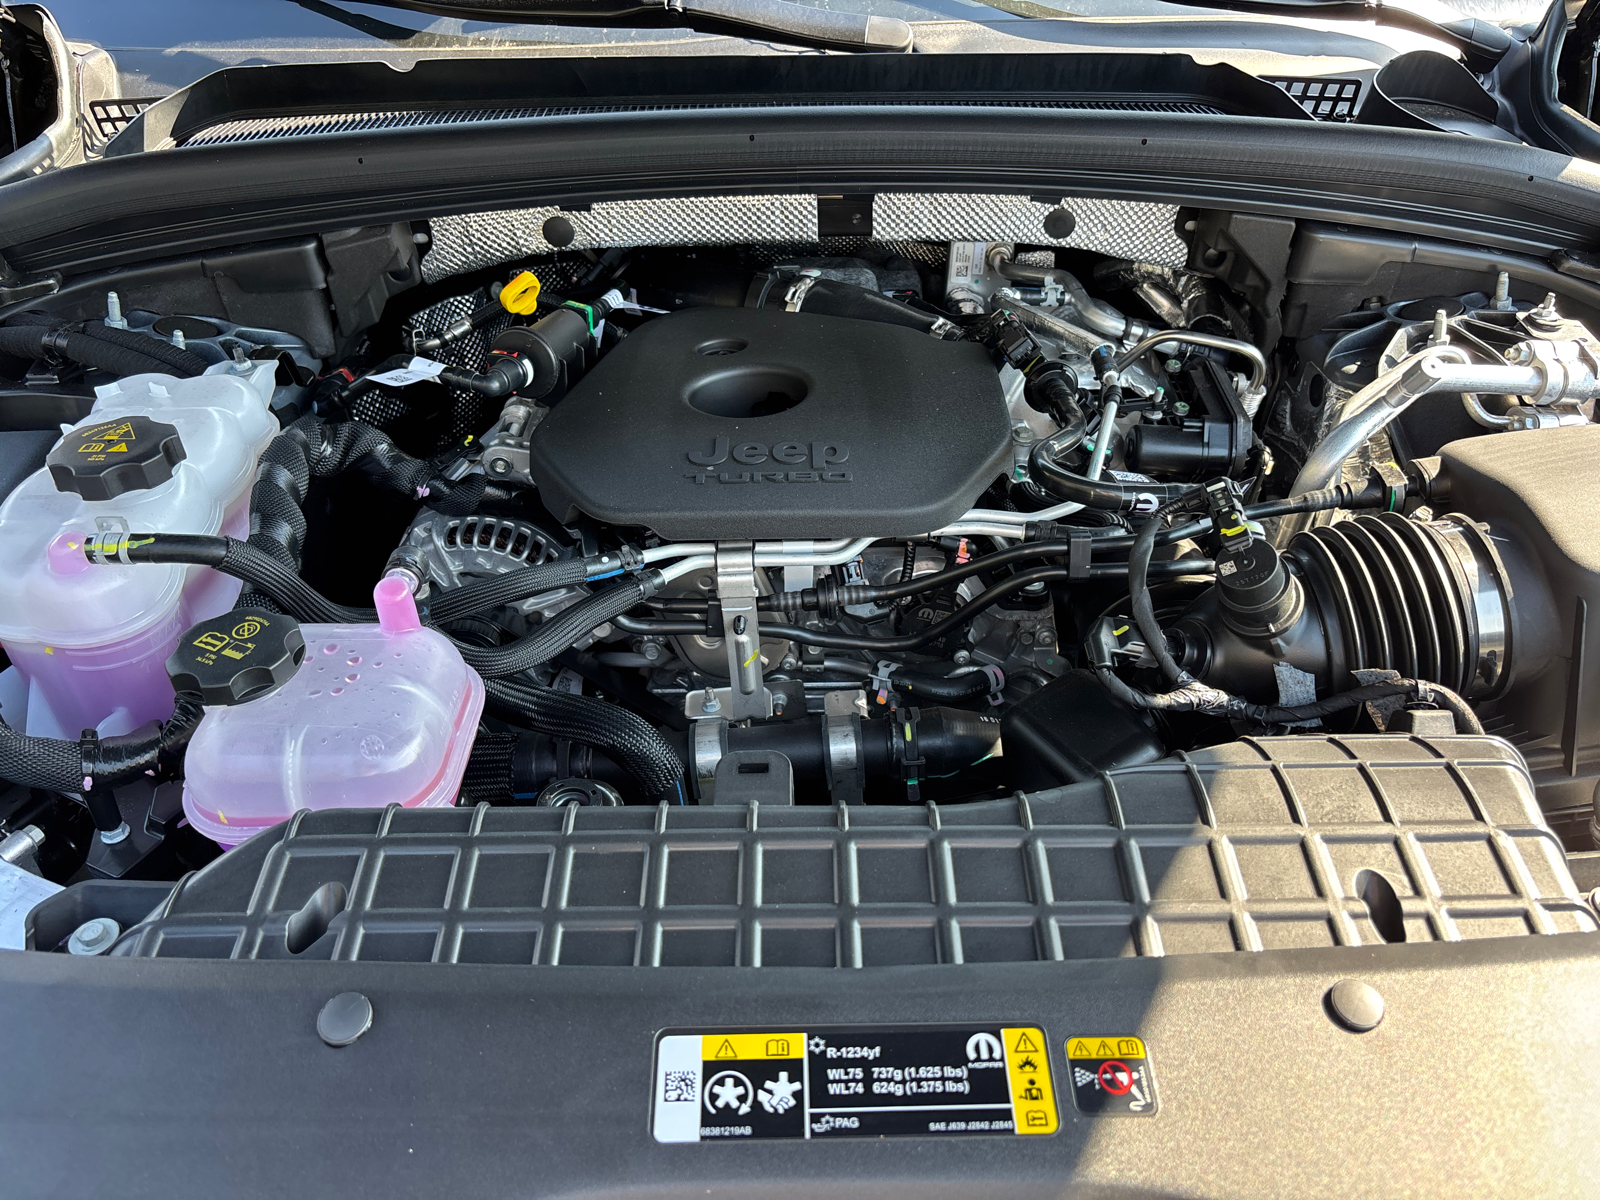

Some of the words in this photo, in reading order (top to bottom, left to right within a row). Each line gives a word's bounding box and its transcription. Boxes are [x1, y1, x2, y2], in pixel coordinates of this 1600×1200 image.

[687, 436, 850, 471] Jeep
[684, 471, 854, 485] TURBO
[826, 1046, 881, 1060] R-1234yf
[967, 1061, 1004, 1069] MOPAR
[826, 1068, 864, 1080] WL75
[871, 1067, 903, 1081] 737g
[904, 1066, 942, 1080] (1.625
[943, 1065, 969, 1080] lbs)
[827, 1082, 865, 1095] WL74
[872, 1081, 904, 1096] 624g
[905, 1081, 944, 1096] (1.375
[944, 1080, 971, 1095] lbs)
[835, 1117, 860, 1129] PAG
[928, 1121, 947, 1131] SAE
